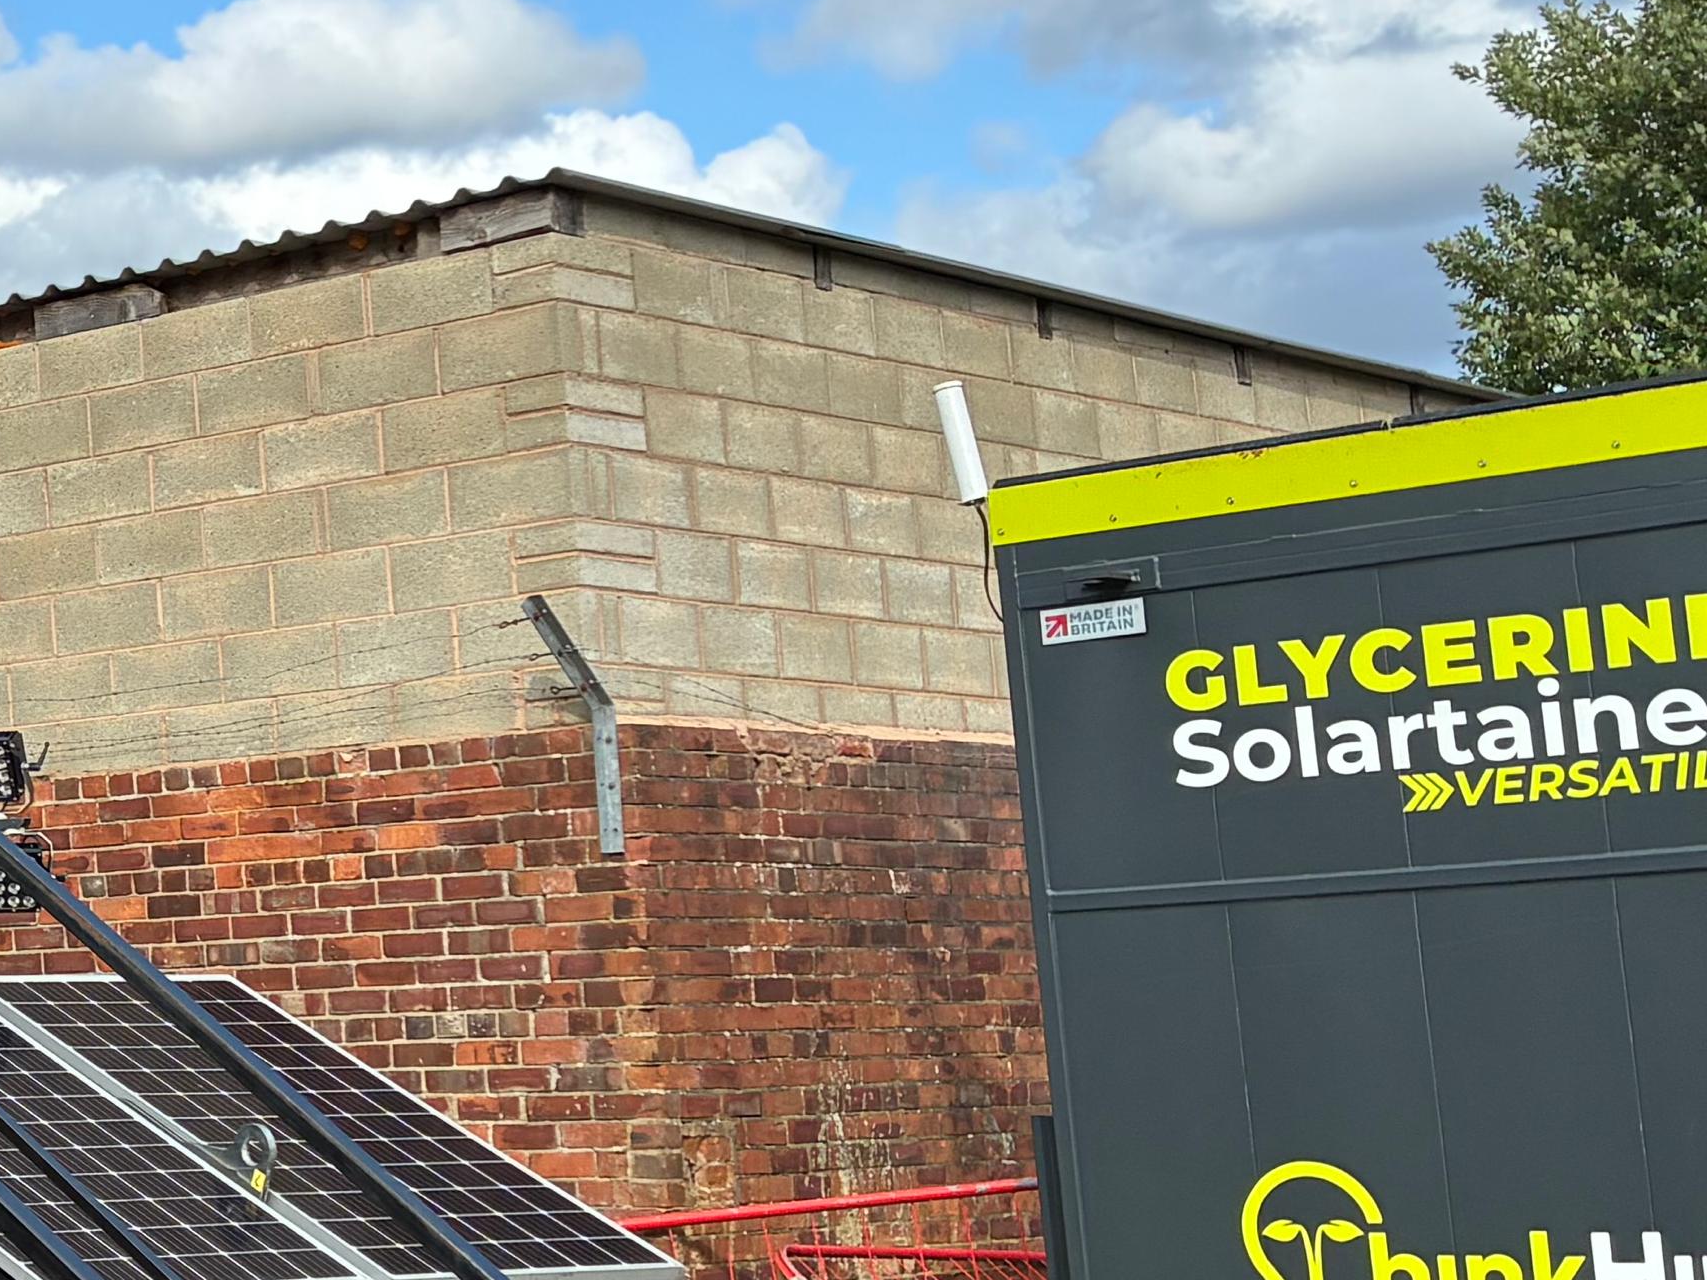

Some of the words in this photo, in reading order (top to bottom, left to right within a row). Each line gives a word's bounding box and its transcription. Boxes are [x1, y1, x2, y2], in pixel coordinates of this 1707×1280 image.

[1070, 607, 1113, 623] MADE
[1117, 604, 1133, 617] IN
[1071, 617, 1134, 636] BRITAIN
[1172, 677, 1707, 788] Solartaine
